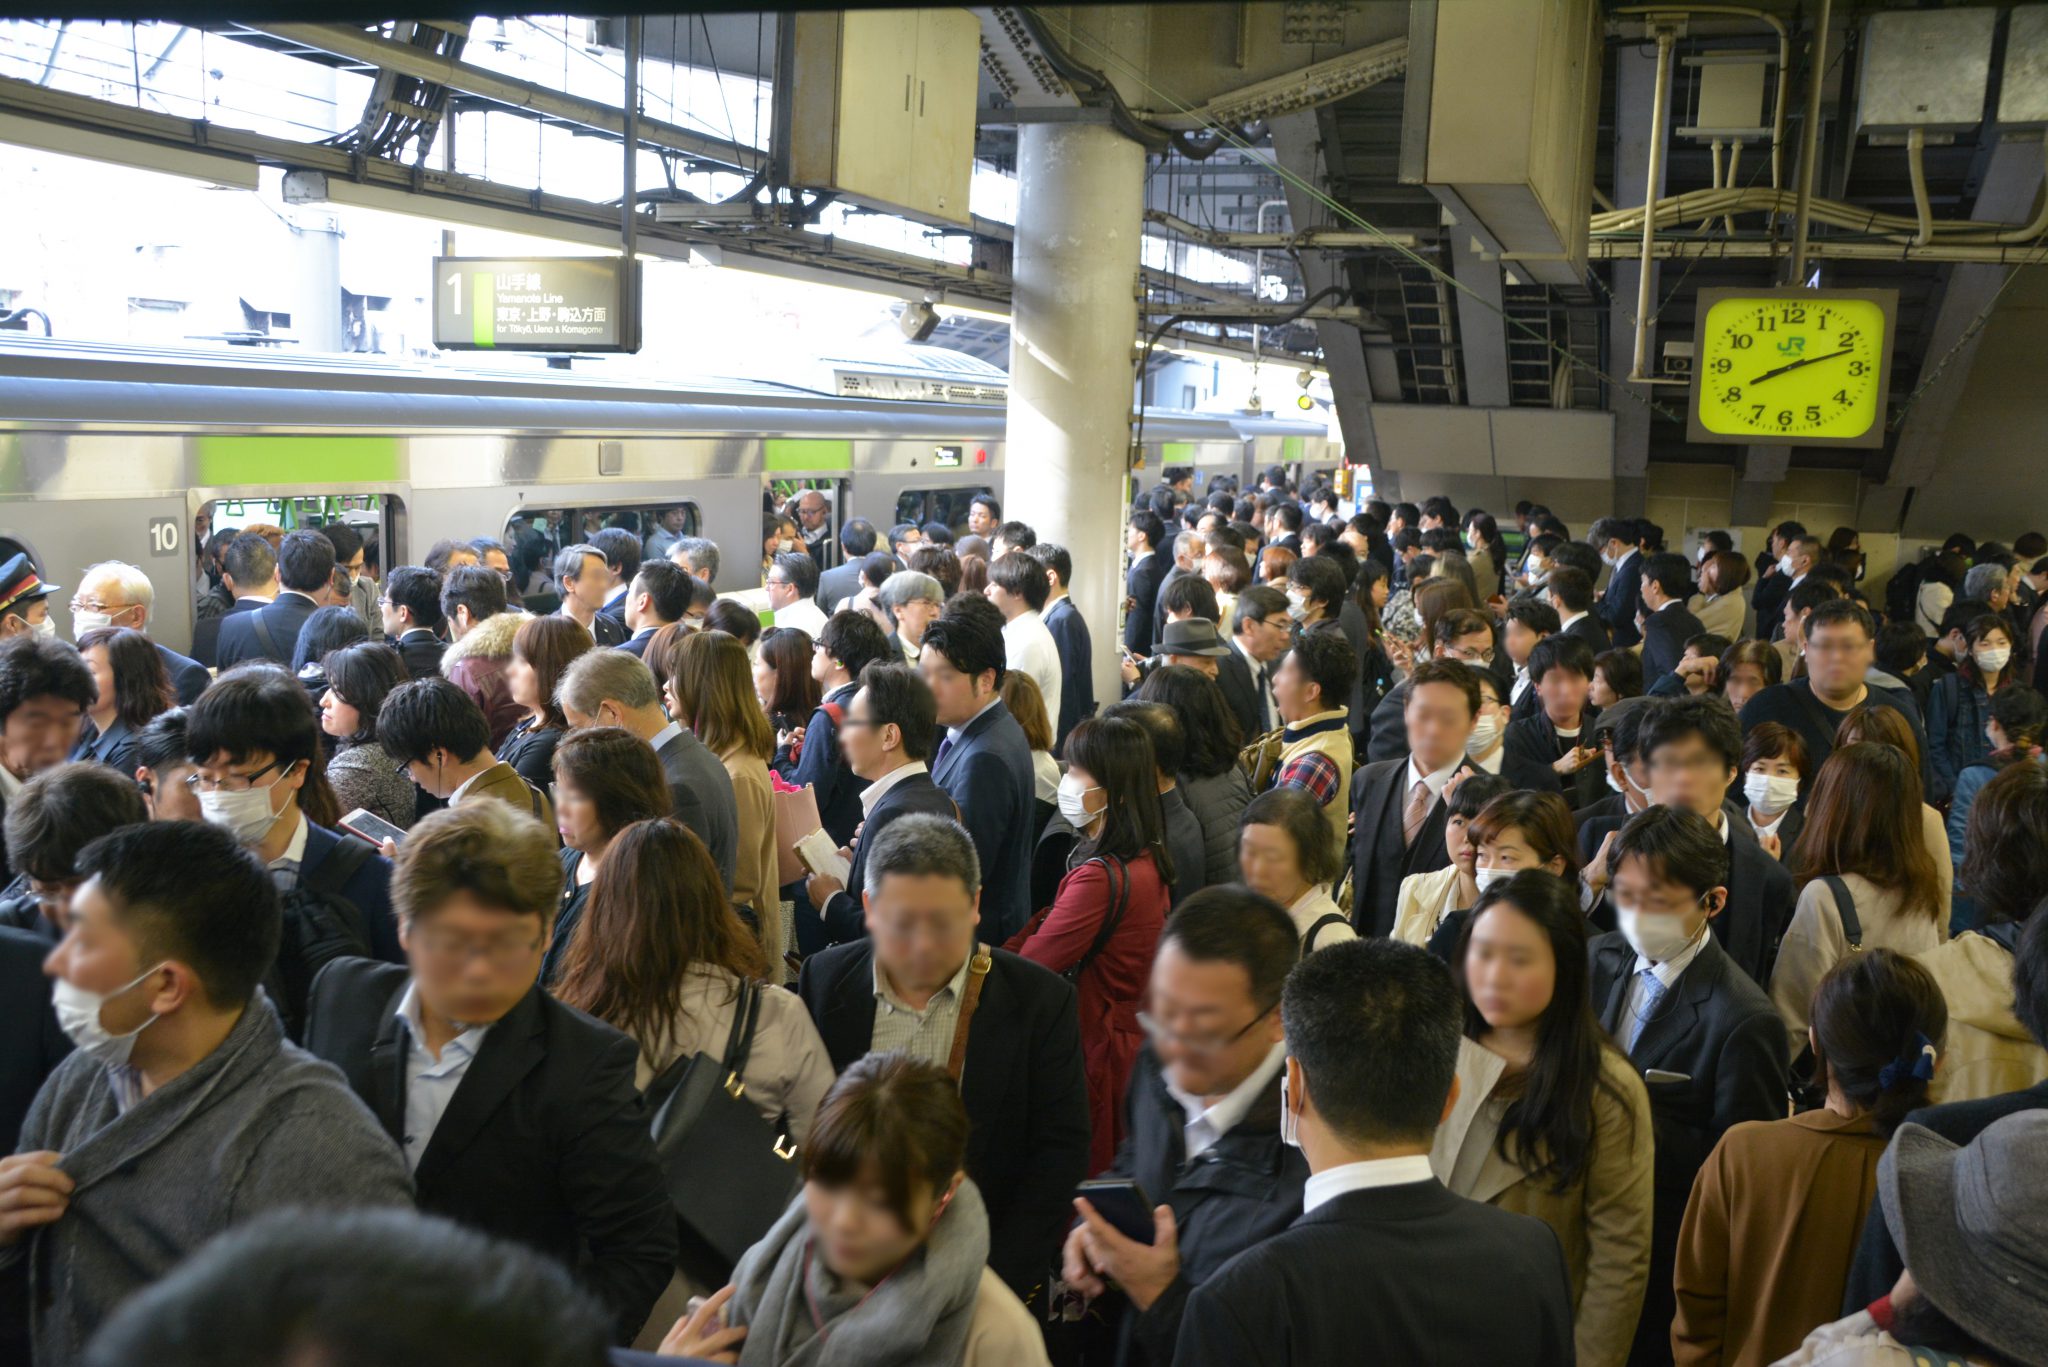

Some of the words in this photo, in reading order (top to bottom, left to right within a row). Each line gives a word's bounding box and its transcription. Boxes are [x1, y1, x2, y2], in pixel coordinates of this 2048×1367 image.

[496, 272, 542, 291] 山手線
[446, 272, 462, 315] 1
[497, 293, 541, 304] Yamanote
[543, 293, 564, 304] Line
[1756, 316, 1776, 332] 11
[1781, 308, 1806, 324] 12
[1817, 314, 1827, 330] 1
[497, 324, 507, 334] for
[534, 325, 553, 334] Ueno
[555, 325, 561, 334] &
[562, 324, 604, 335] Komagome
[1730, 334, 1754, 350] 10
[1777, 336, 1805, 352] JR
[1838, 332, 1854, 348] 2
[1716, 358, 1732, 374] 9
[1848, 360, 1864, 377] 3
[1725, 386, 1742, 402] 8
[1832, 389, 1849, 405] 4
[1751, 404, 1766, 420] 7
[1777, 410, 1793, 426] 6
[1805, 405, 1821, 421] 5
[150, 522, 178, 551] 10
